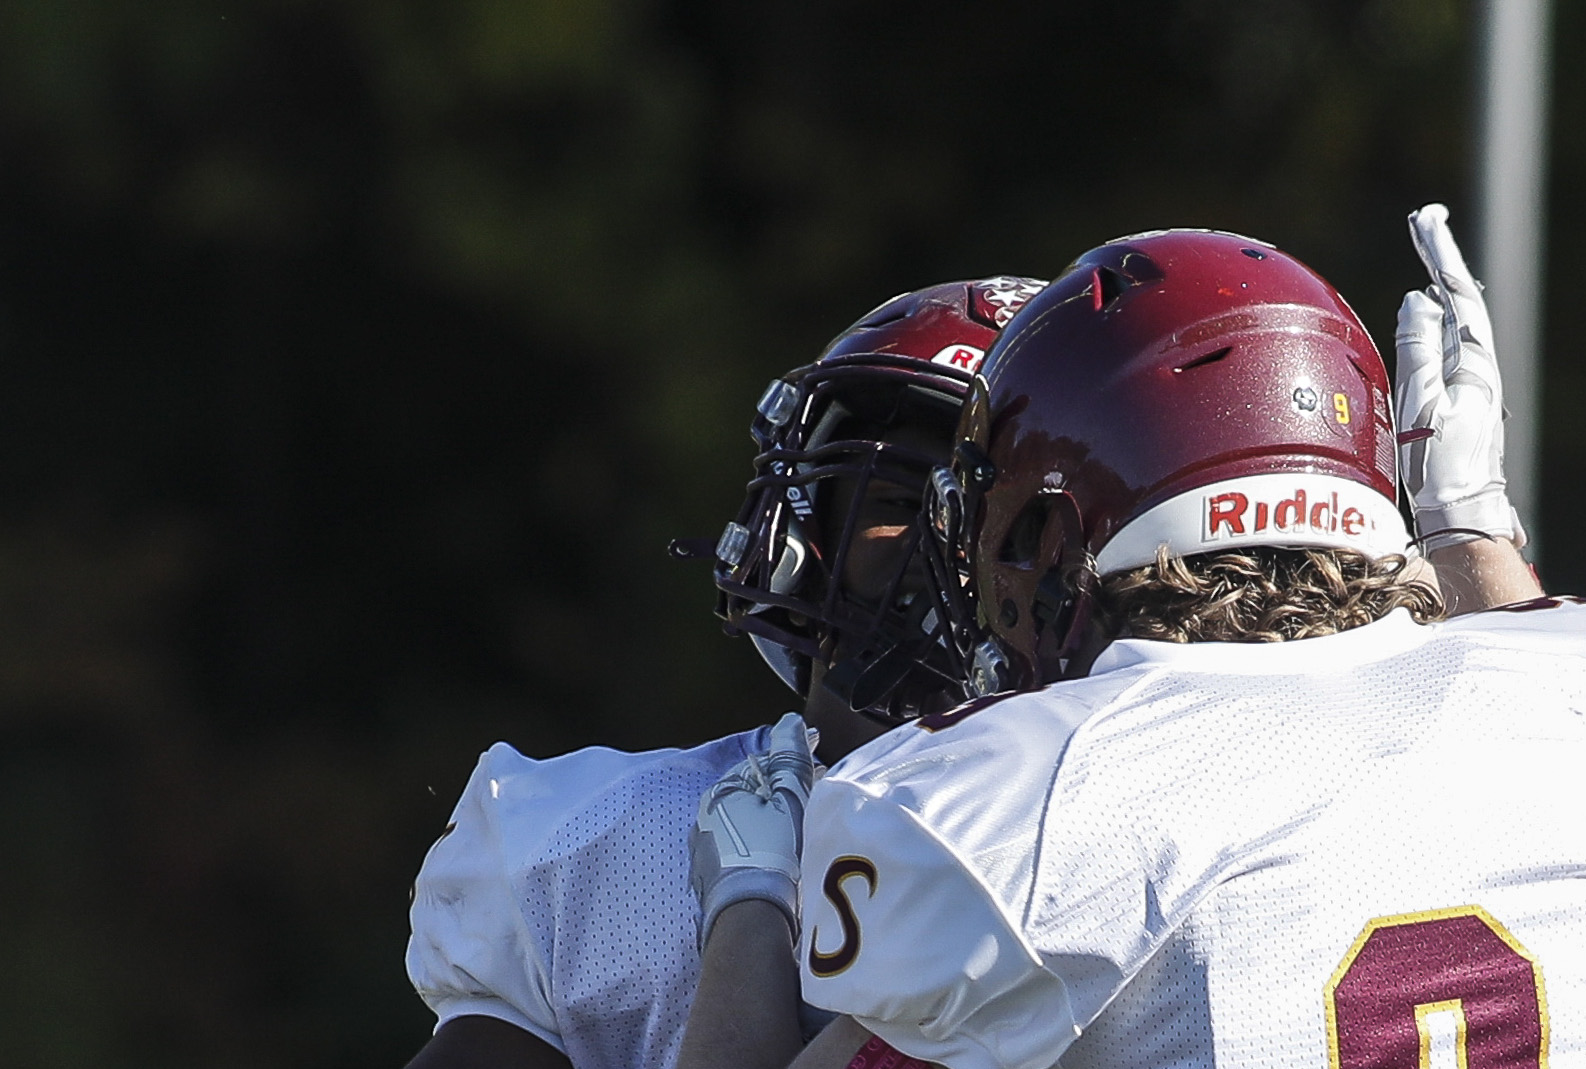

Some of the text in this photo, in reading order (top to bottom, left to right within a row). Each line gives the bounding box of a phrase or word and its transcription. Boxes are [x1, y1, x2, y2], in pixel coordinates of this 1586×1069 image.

[1333, 393, 1350, 425] 9
[1201, 488, 1376, 543] Ridde
[811, 855, 880, 978] S
